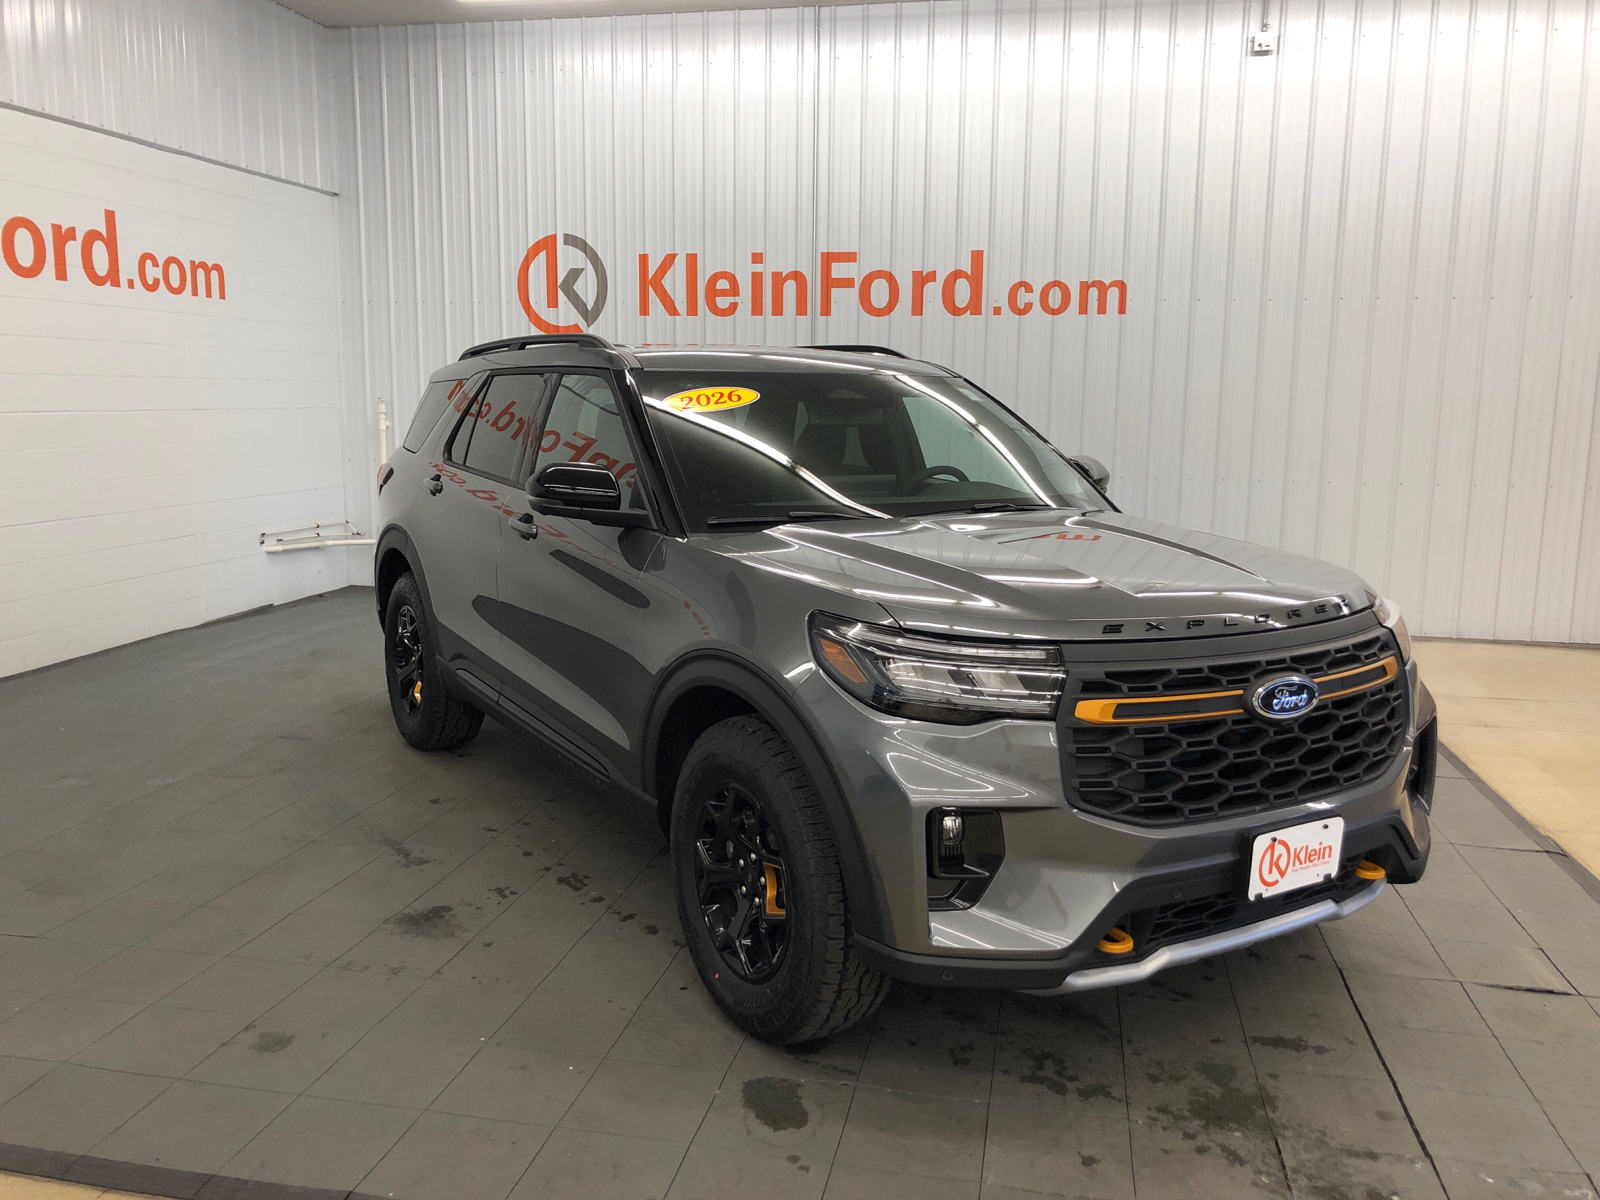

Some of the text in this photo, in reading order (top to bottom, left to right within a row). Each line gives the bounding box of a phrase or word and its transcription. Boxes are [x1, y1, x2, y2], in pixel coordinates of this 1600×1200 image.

[638, 250, 1128, 318] KleinFord.com
[679, 389, 743, 410] 2026
[1102, 597, 1351, 634] EXPLORER
[1272, 685, 1309, 711] Ford
[1292, 841, 1333, 867] Klein
